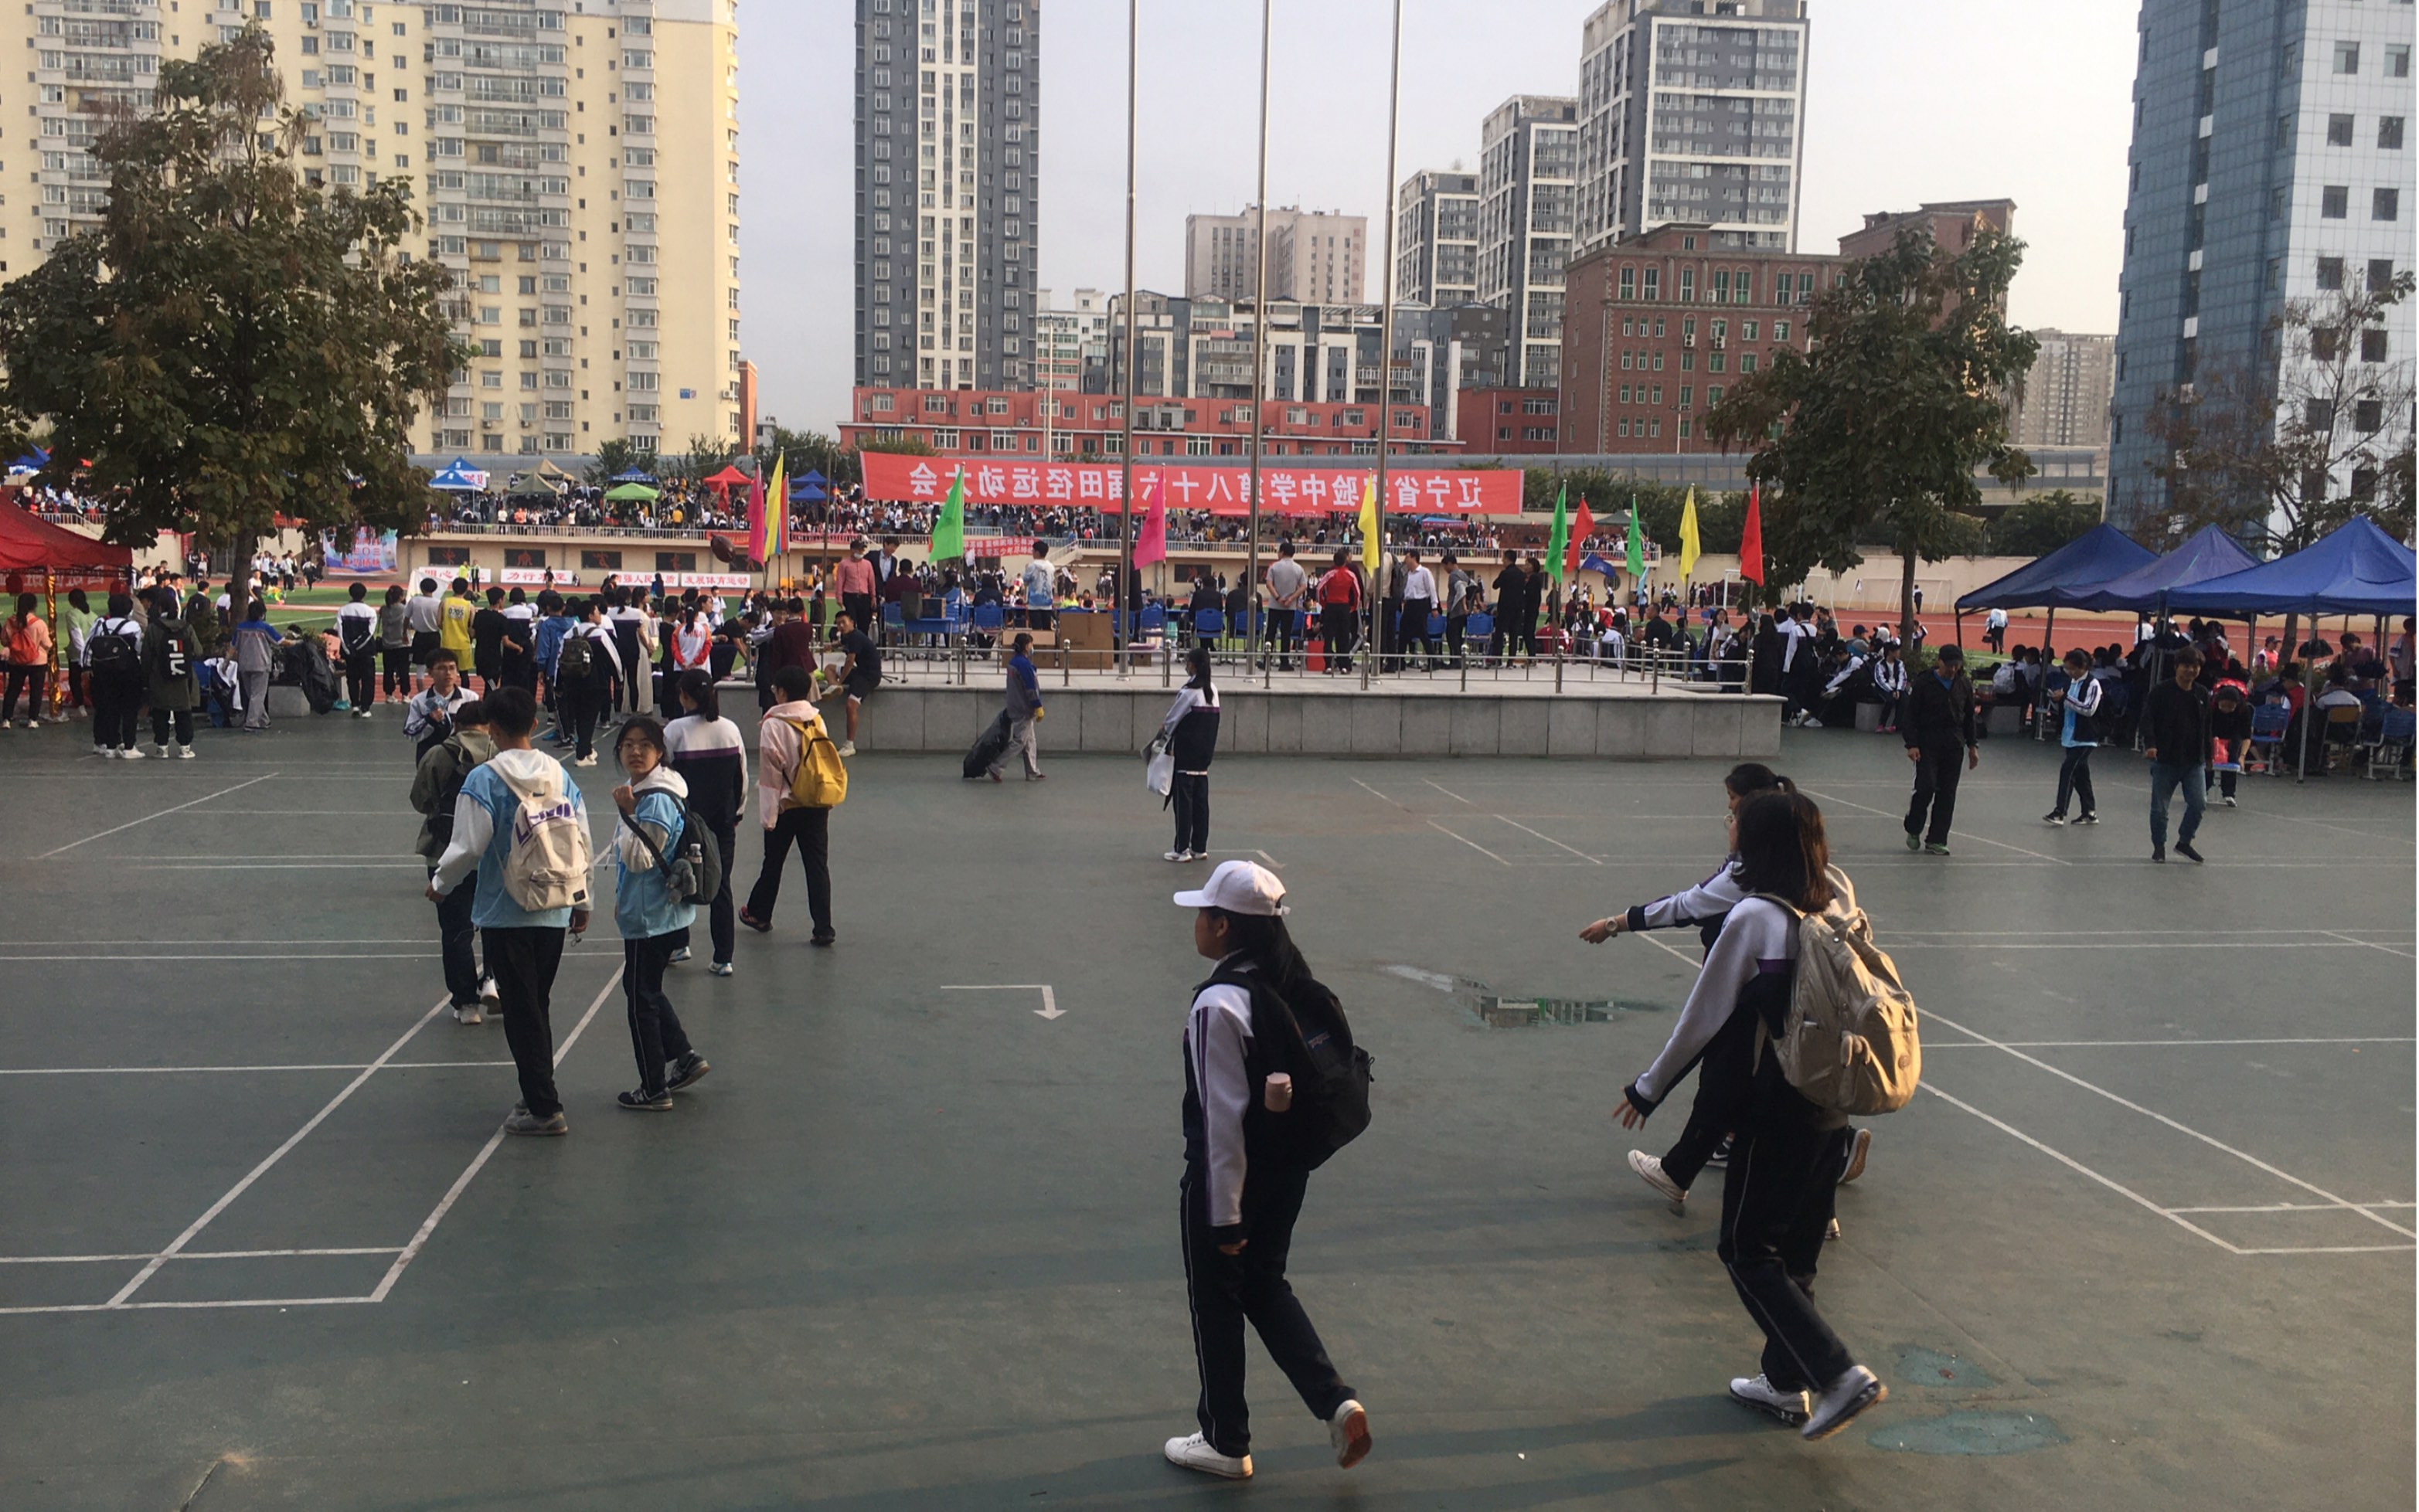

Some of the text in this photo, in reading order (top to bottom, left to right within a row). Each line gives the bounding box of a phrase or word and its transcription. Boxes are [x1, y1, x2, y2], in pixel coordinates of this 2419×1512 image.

[617, 573, 675, 584] 强人民质
[685, 576, 748, 586] 发展体育运动
